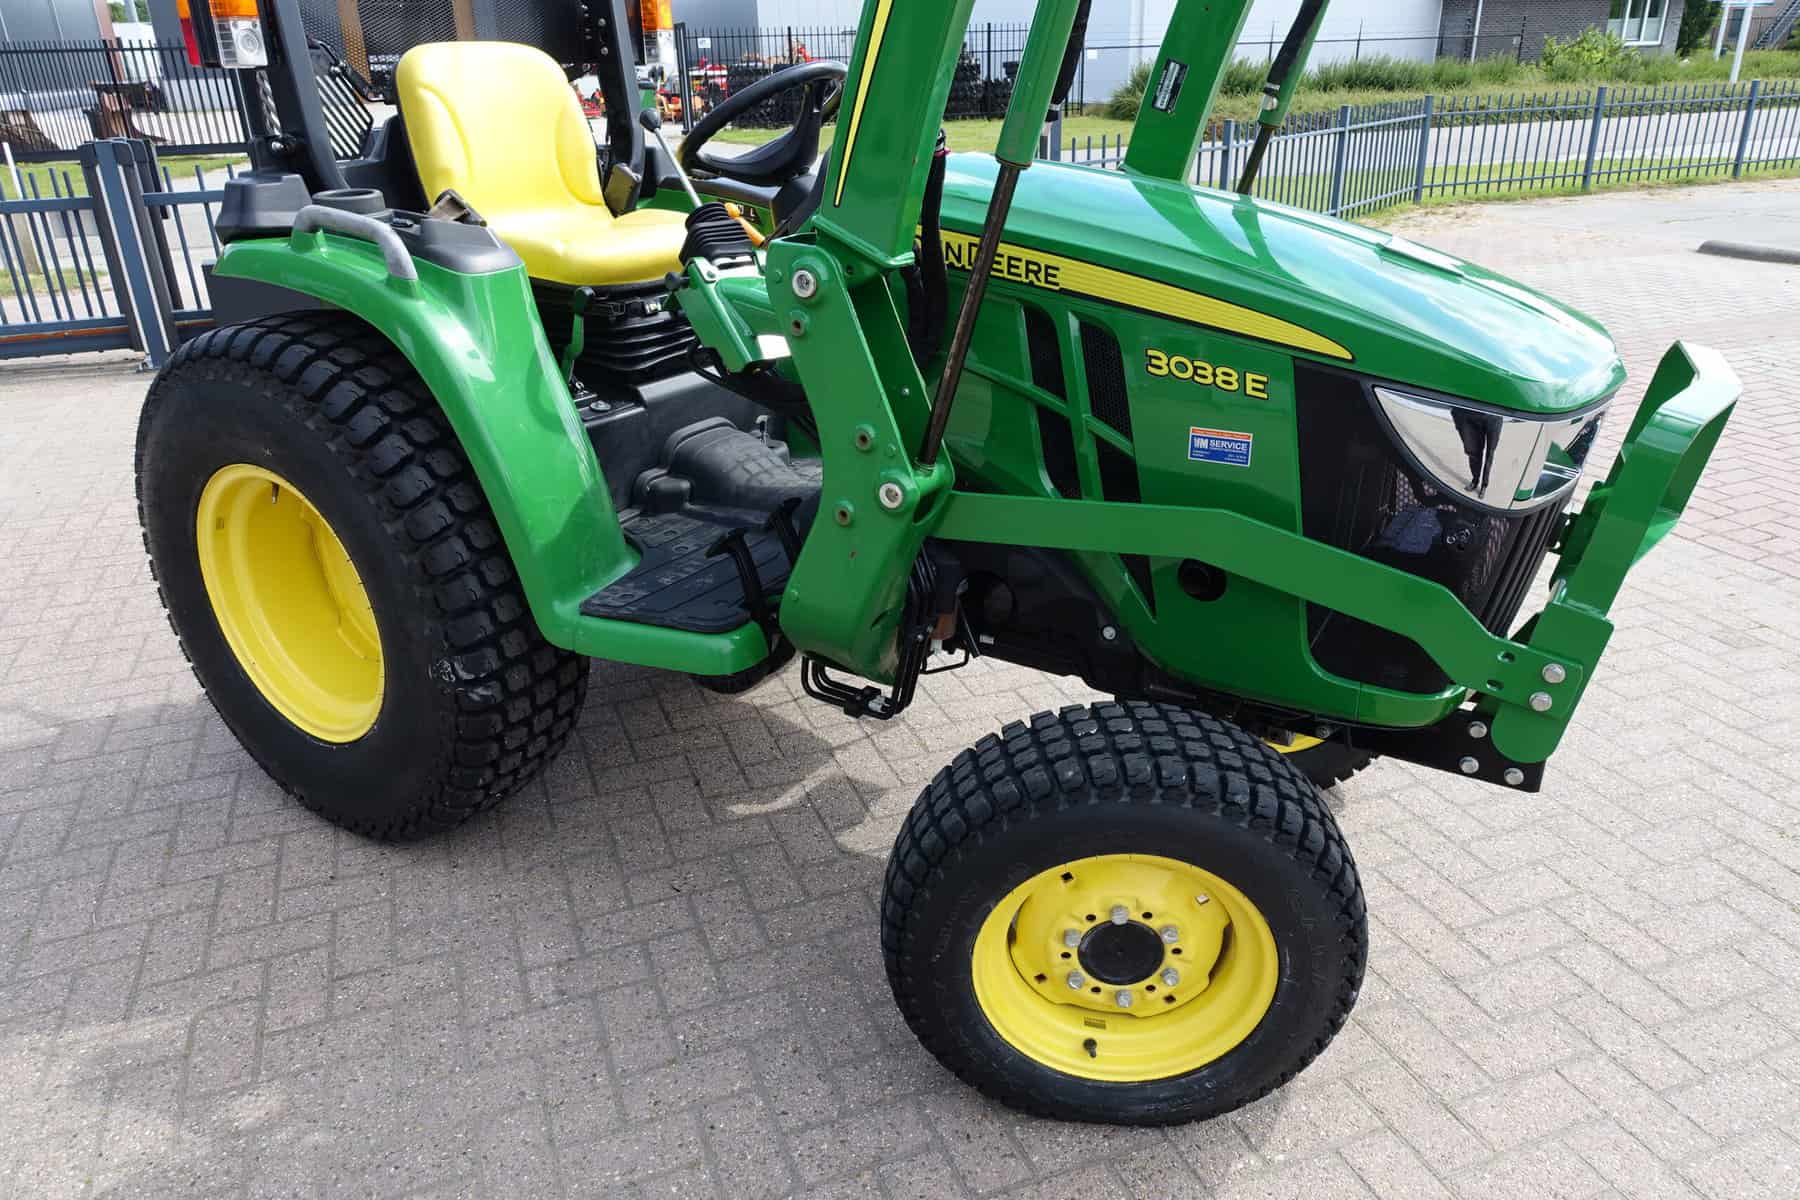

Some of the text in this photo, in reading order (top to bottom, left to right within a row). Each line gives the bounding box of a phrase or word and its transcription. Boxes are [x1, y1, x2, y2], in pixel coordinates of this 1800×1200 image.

[1145, 348, 1269, 400] 3038 E
[1209, 439, 1248, 451] SERVICE
